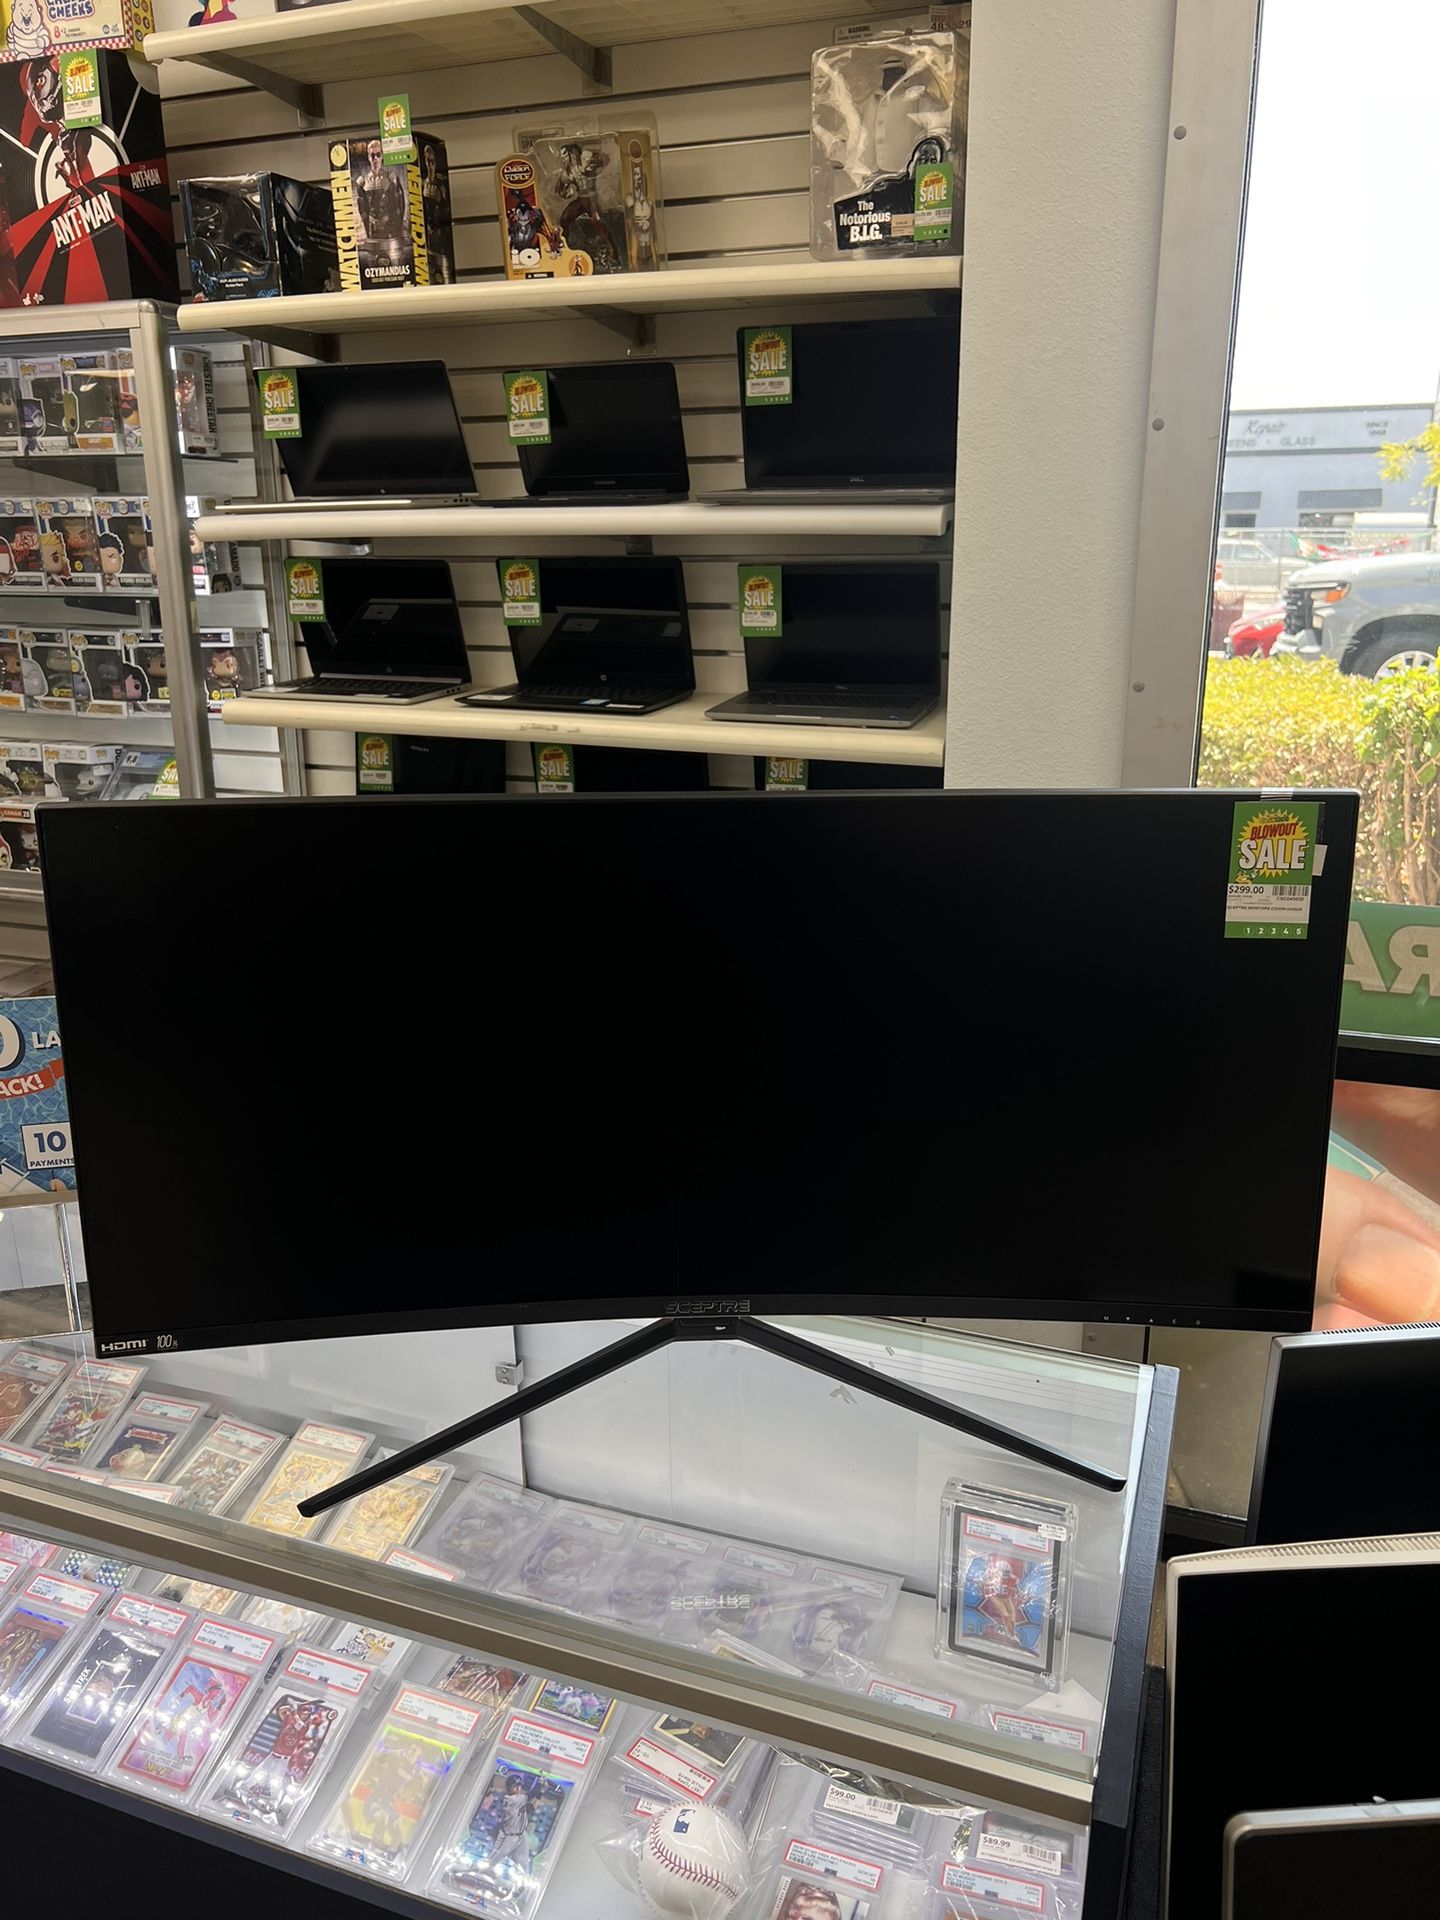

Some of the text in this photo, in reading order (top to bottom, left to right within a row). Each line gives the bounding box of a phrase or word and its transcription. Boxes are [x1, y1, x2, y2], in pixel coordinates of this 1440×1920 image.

[48, 1, 93, 19] CHEEKS
[66, 75, 95, 94] SALE
[384, 115, 406, 131] SALE
[920, 184, 947, 202] SALE
[857, 201, 874, 211] The
[407, 164, 429, 288] WATCHMEN
[840, 212, 891, 226] Notorious
[330, 171, 362, 293] WATCHMEN
[849, 225, 883, 242] B.I.G.
[364, 265, 410, 278] OZYMANDIAS
[750, 351, 786, 372] SALE
[203, 357, 217, 434] CHESTER CHEETAH
[265, 390, 295, 409] SALE
[511, 393, 544, 414] SALE
[1279, 436, 1316, 447] GLASS
[290, 578, 319, 594] SALE
[505, 579, 536, 596] SALE
[744, 590, 774, 606] SALE
[362, 750, 389, 765] SALE
[540, 760, 570, 776] SALE
[770, 761, 803, 778] SALE
[1250, 822, 1299, 840] BLOWOUT
[1239, 838, 1307, 870] SALE
[1228, 885, 1265, 894] $299.00
[1258, 927, 1264, 935] 2
[1271, 927, 1277, 935] 3
[1283, 927, 1289, 935] 4
[1296, 927, 1302, 936] 5
[33, 1131, 67, 1153] 10
[664, 1299, 751, 1314] SCEPTRE
[101, 1339, 147, 1352] HDMI
[829, 1787, 856, 1801] $99.00
[983, 1836, 1011, 1848] $89.99
